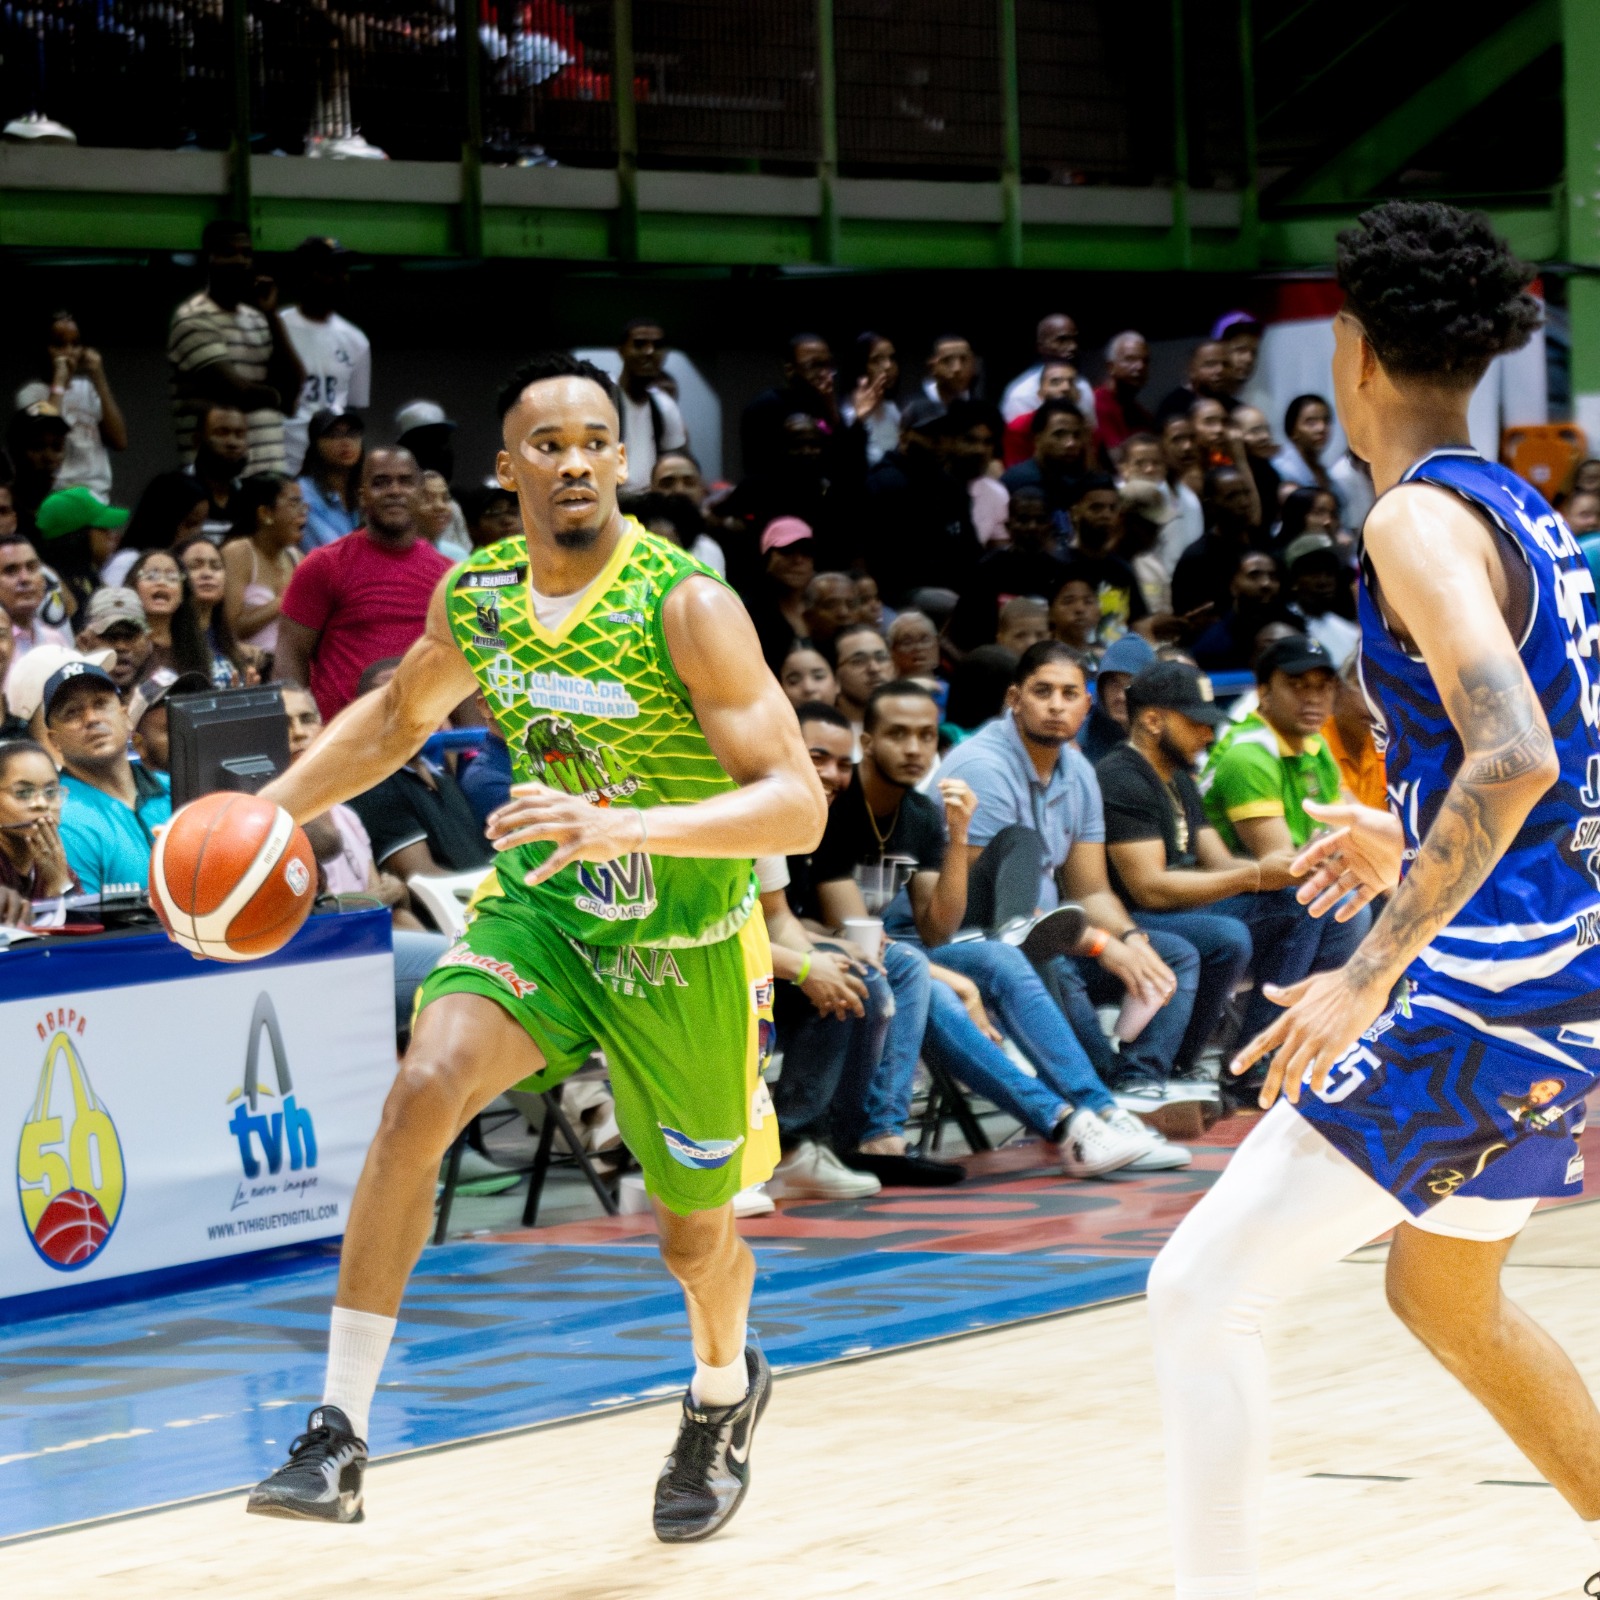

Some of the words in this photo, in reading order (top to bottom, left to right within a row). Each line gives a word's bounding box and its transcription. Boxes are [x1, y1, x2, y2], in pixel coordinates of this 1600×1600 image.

[36, 1007, 87, 1042] ABAPA
[229, 1094, 319, 1180] tvh
[207, 1203, 339, 1240] WWW.TVHIGUEYDIGITAL.COM
